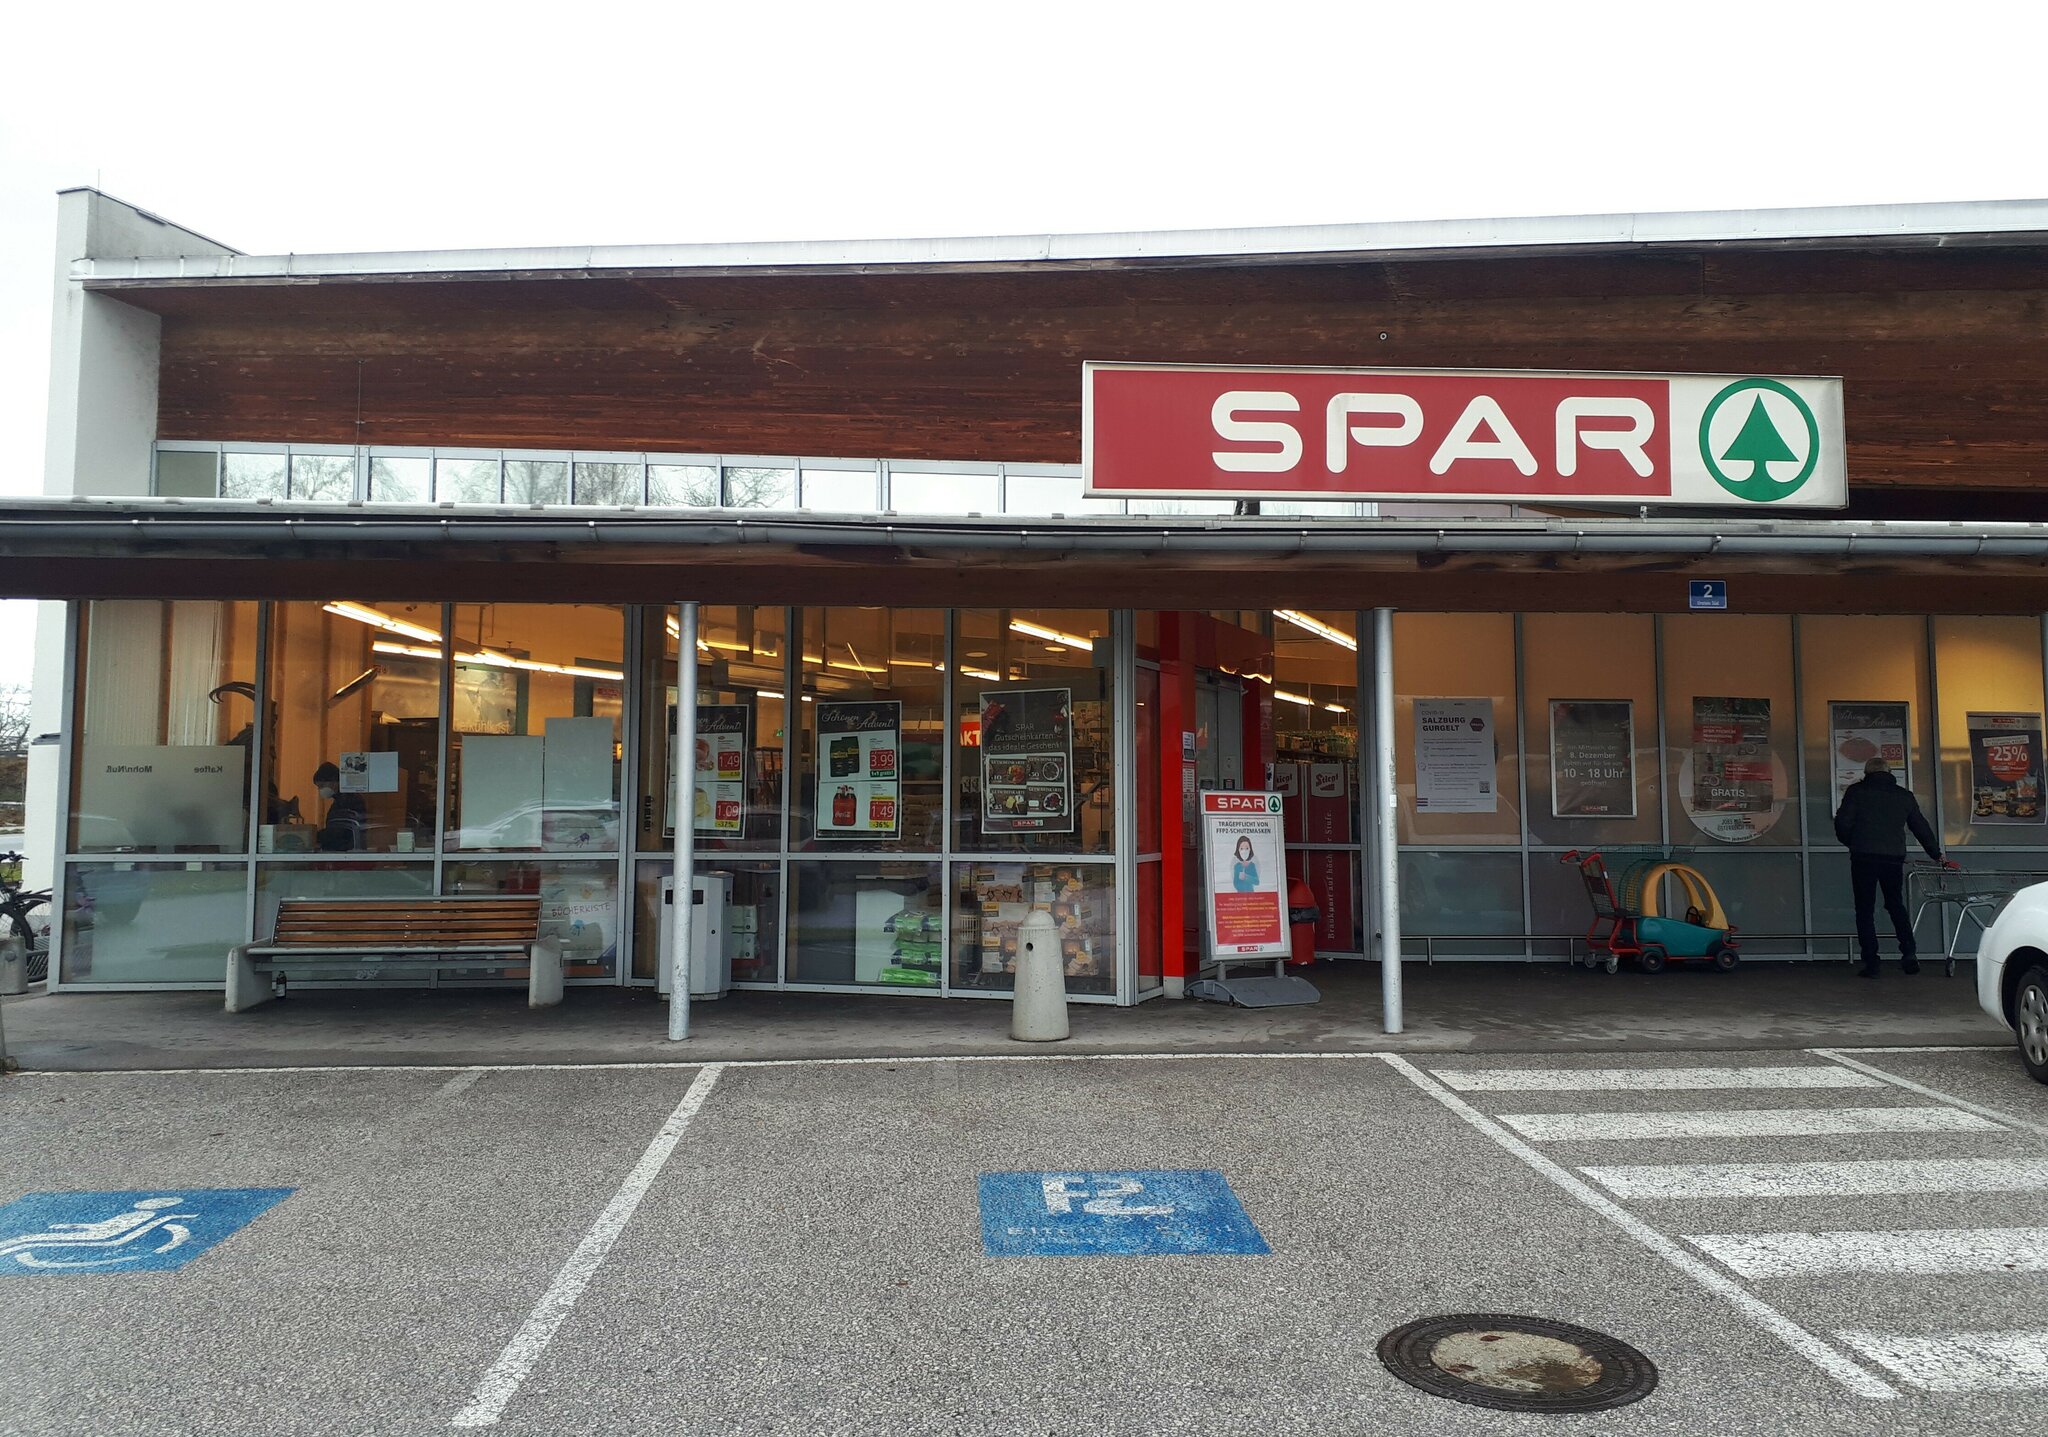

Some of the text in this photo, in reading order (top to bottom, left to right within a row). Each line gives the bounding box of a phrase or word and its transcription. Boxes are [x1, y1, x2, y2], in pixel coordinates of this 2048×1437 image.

[1211, 390, 1656, 478] SPAR
[1703, 584, 1713, 598] 2
[1015, 723, 1035, 731] SPAR
[1881, 747, 1902, 758] 5.99
[1989, 746, 2028, 762] -25%
[719, 756, 740, 768] 1.49
[870, 754, 894, 767] 3.99
[1564, 768, 1576, 778] 10
[1588, 768, 1600, 778] 18
[1604, 768, 1624, 778] Uhr
[1711, 788, 1745, 797] GRATIS
[1217, 797, 1265, 809] SPAR
[716, 804, 739, 818] 1.09
[871, 805, 894, 818] 1.49
[873, 820, 889, 828] -36%
[551, 902, 611, 917] BÜCHERKISTE
